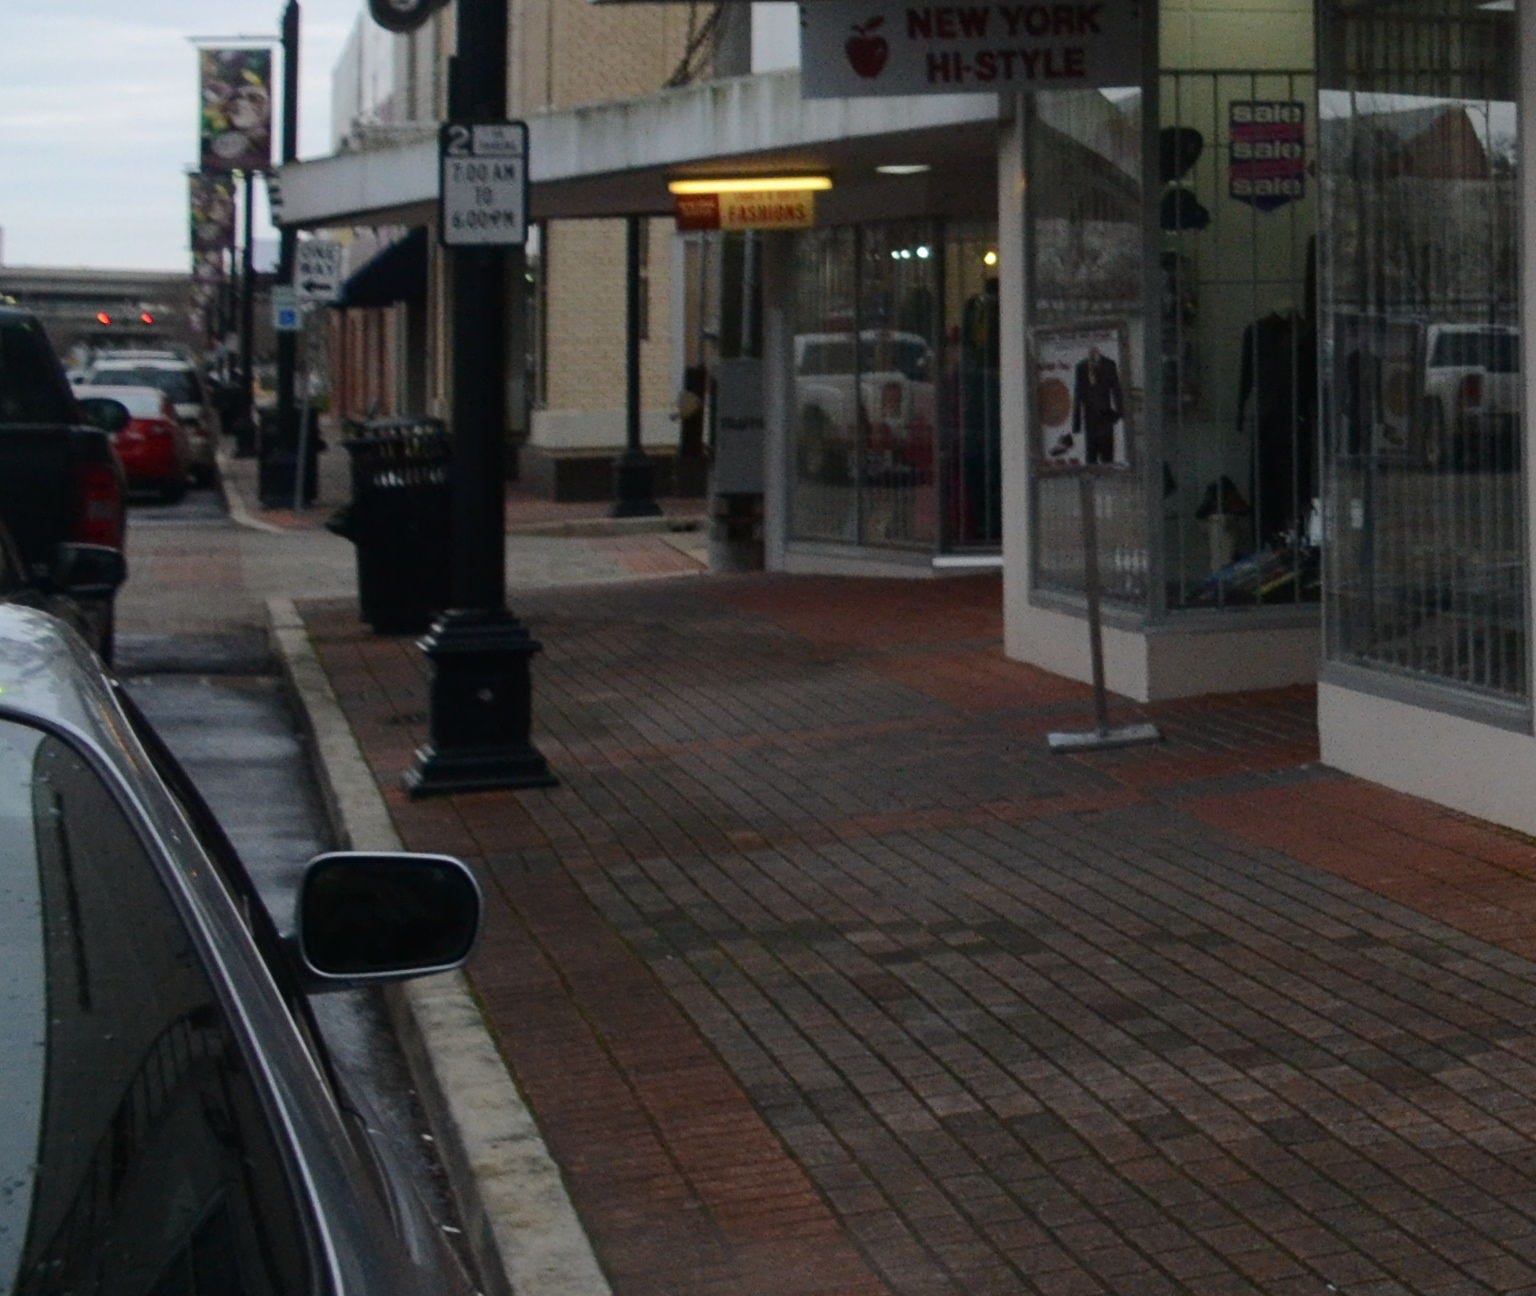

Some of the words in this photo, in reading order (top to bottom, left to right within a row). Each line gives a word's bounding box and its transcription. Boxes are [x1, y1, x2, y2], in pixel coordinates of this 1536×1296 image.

[905, 6, 990, 40] NEW
[1000, 4, 1102, 37] YORK
[926, 46, 1087, 84] HI-STYLE
[448, 125, 470, 154] 2
[493, 163, 515, 181] AM
[475, 186, 493, 206] TO
